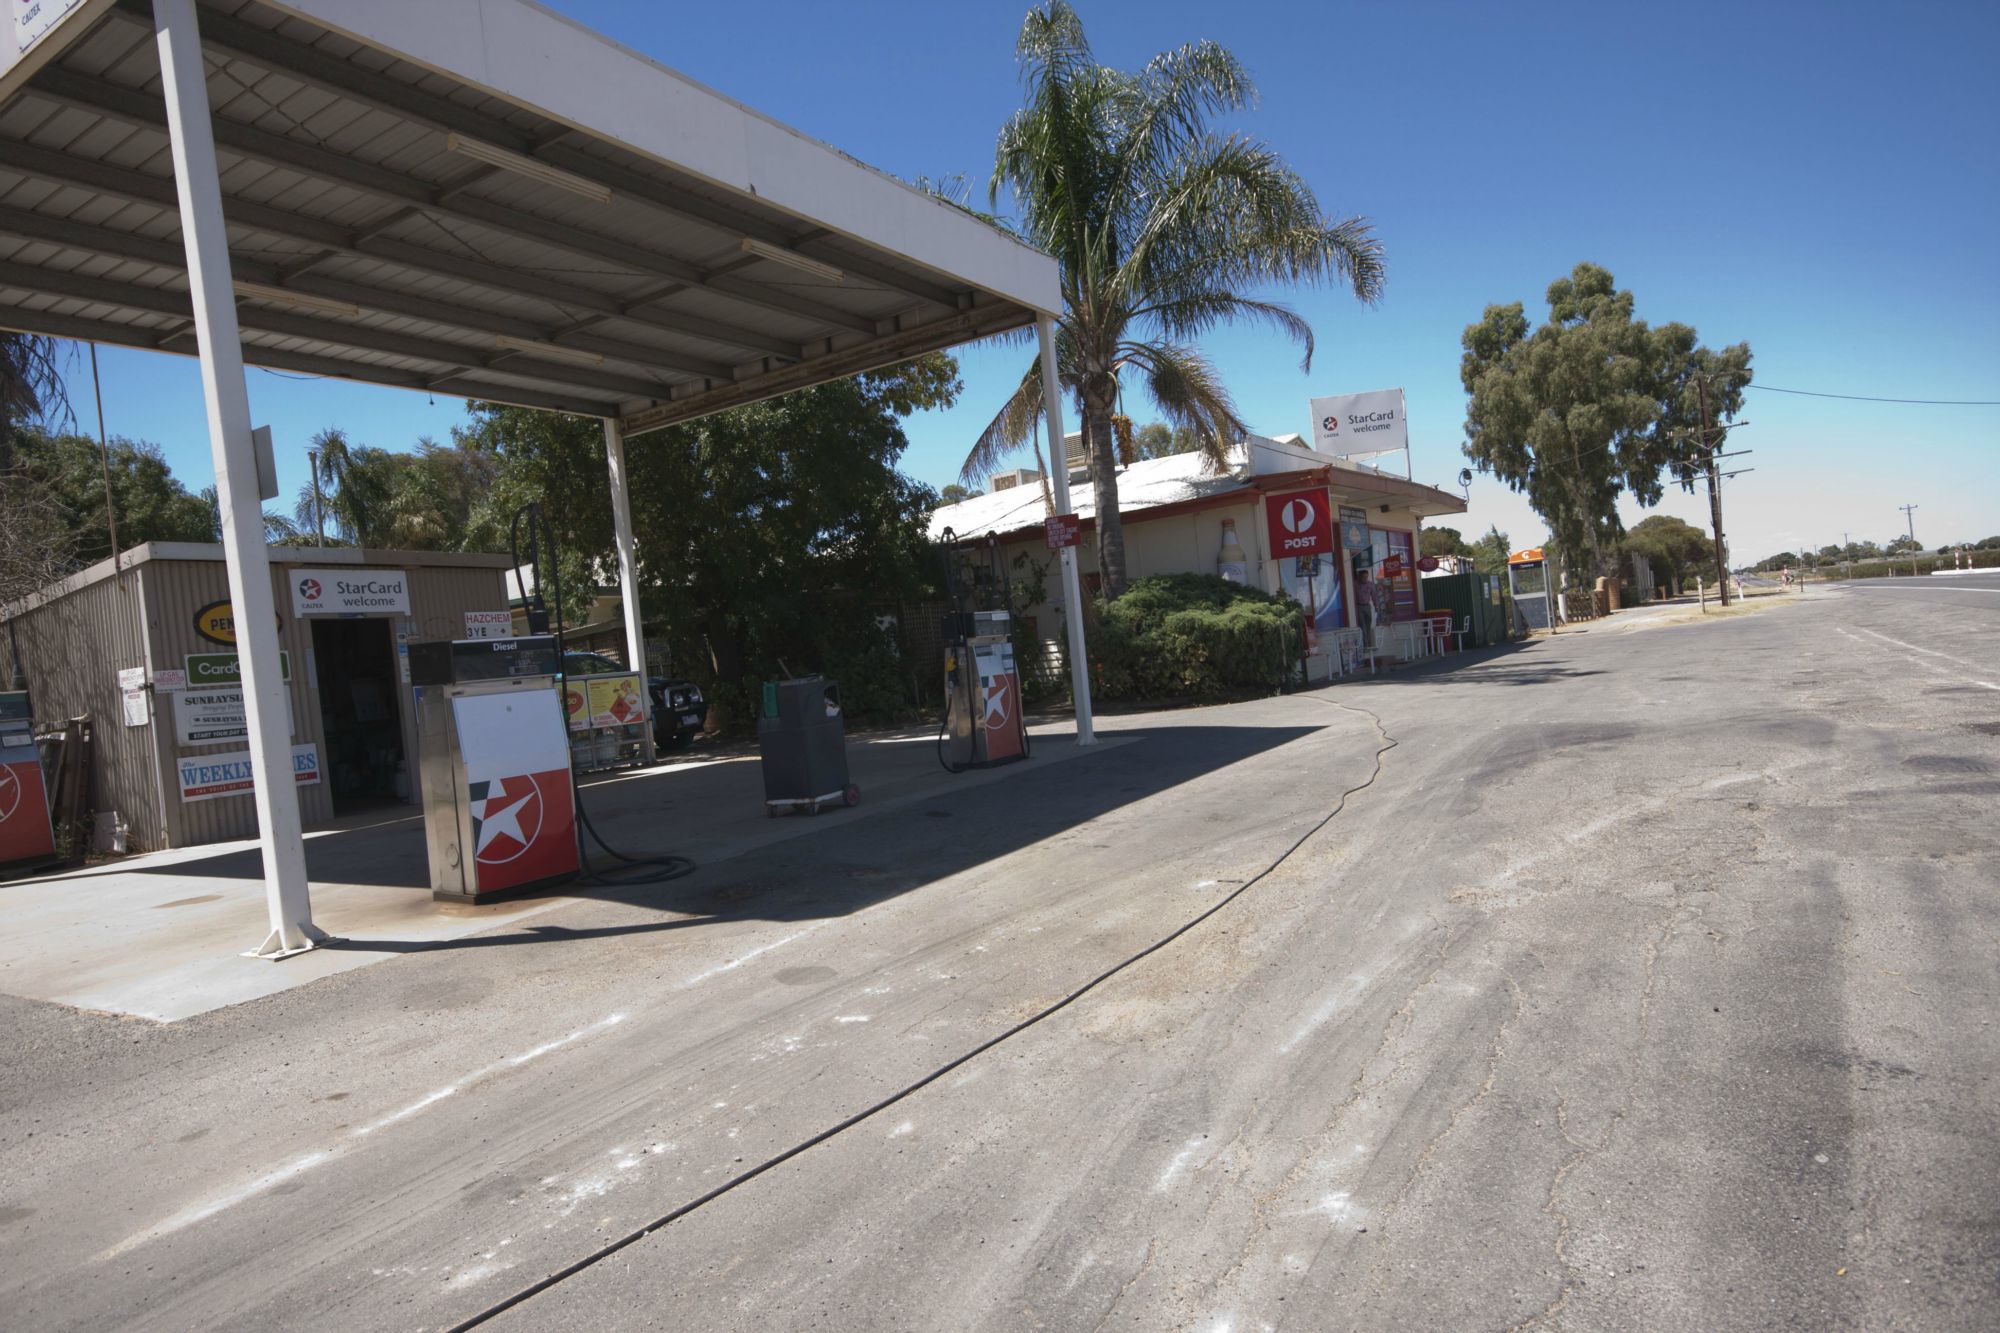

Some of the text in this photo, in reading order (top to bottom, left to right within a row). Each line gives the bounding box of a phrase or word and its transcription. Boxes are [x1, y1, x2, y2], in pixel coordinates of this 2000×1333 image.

[21, 2, 41, 26] CALTEX
[1348, 410, 1394, 424] StarCard
[1353, 423, 1391, 433] welcome
[1284, 536, 1317, 550] POST
[336, 581, 402, 594] StarCard
[343, 596, 396, 607] welcome
[210, 617, 235, 631] PEN
[466, 614, 511, 624] HAZCHEM
[493, 641, 518, 652] Diesel
[181, 760, 253, 785] WEEKLY
